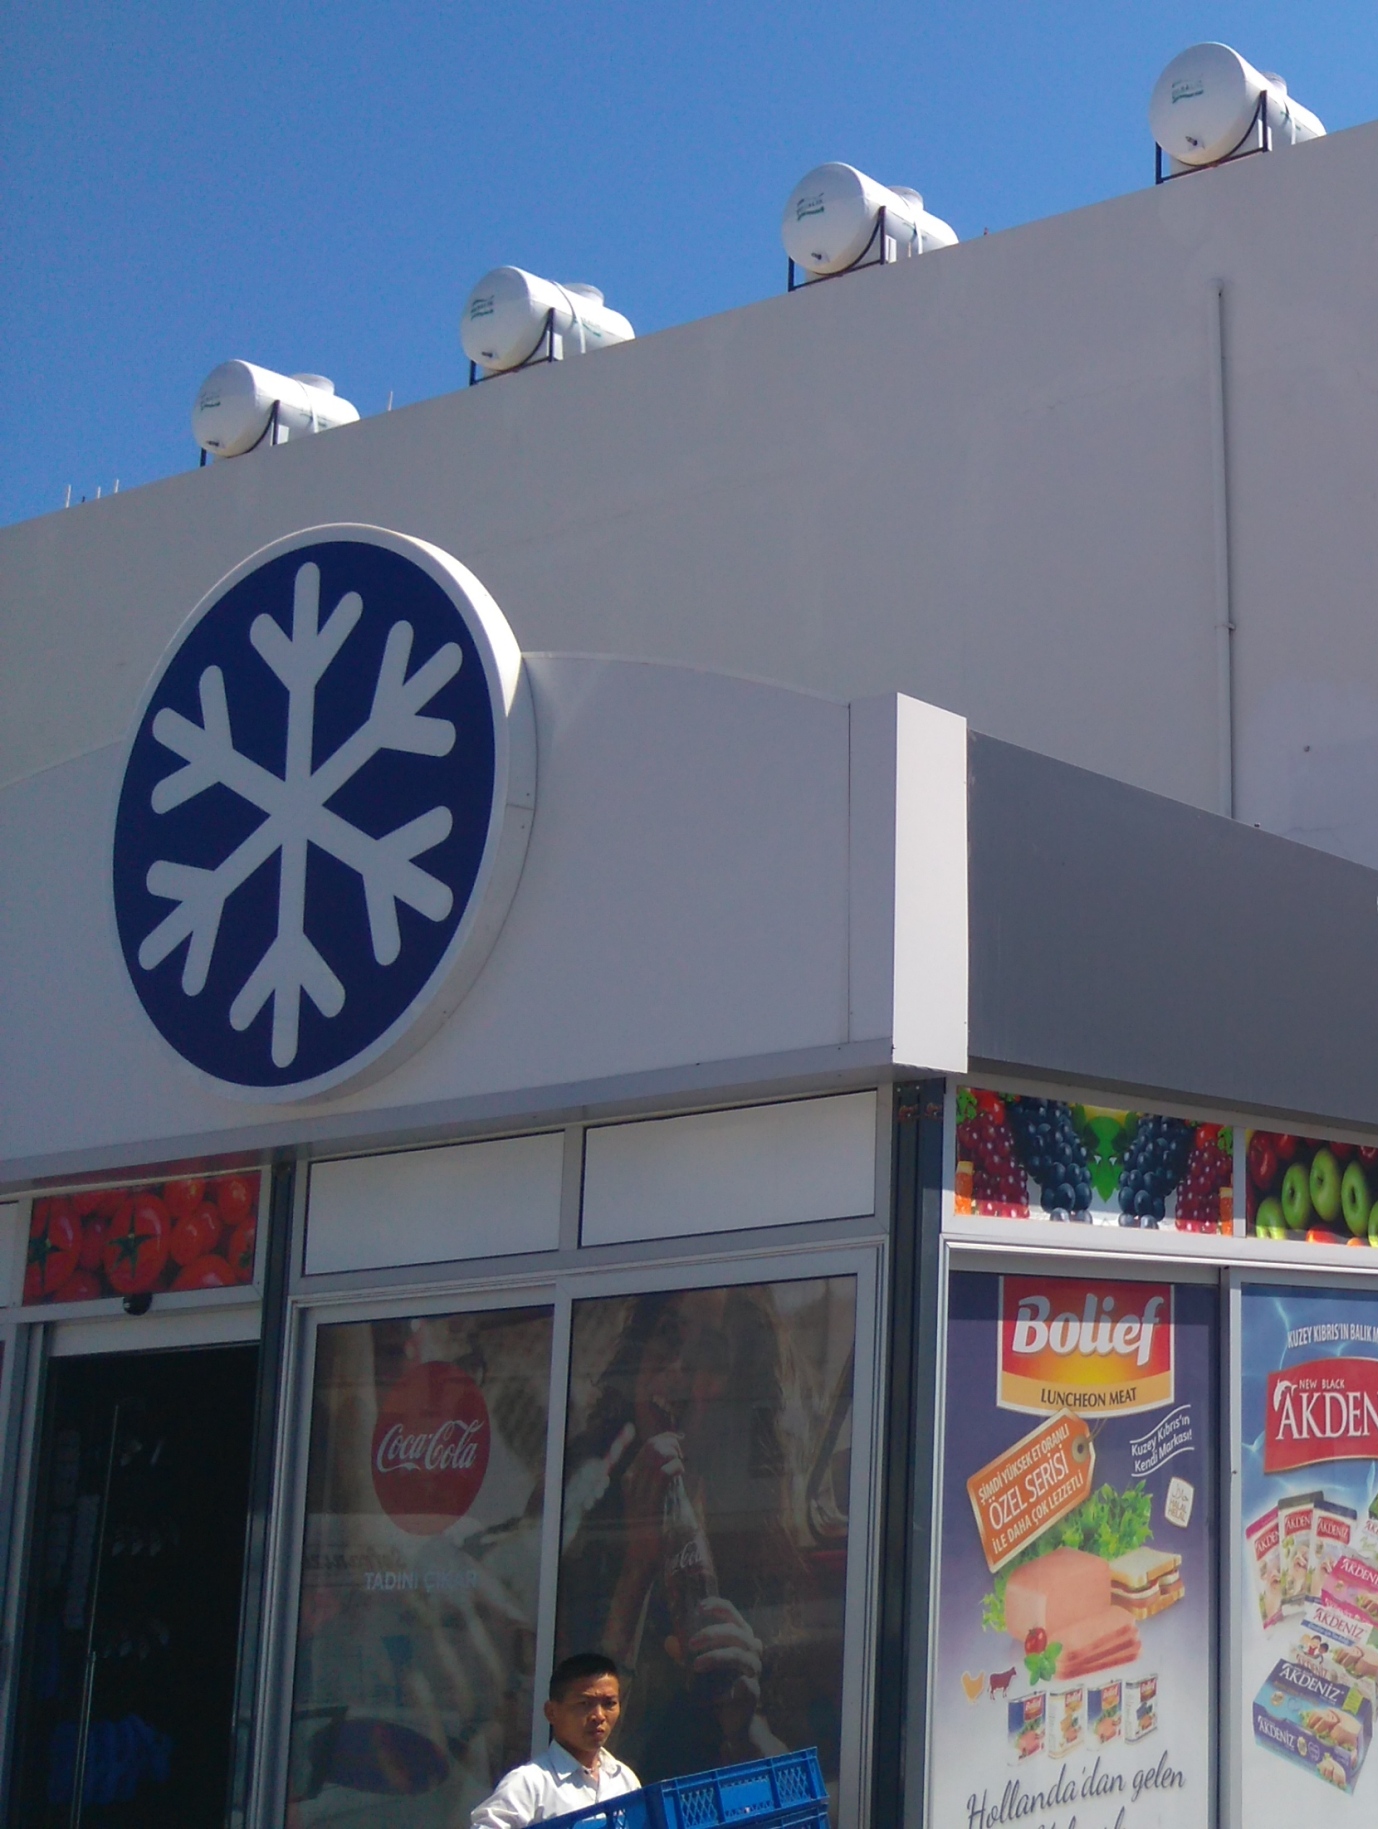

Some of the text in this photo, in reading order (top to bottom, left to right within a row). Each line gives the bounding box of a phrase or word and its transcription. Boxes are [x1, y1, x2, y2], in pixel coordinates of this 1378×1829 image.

[1012, 1293, 1164, 1367] Bolief
[1287, 1326, 1312, 1348] KUZEY
[1313, 1323, 1349, 1342] KIBRIS'IN
[1350, 1323, 1372, 1342] BALIK
[1041, 1386, 1137, 1408] LUNCHEON MEAT
[1299, 1379, 1345, 1390] NEW BLACK
[377, 1419, 485, 1473] Coca-Cola
[1001, 1454, 1033, 1484] YÜKSEK
[1031, 1444, 1042, 1463] ET
[1041, 1423, 1070, 1454] ORANLI
[1131, 1435, 1157, 1457] Kuzey
[1134, 1450, 1158, 1473] Kendi
[989, 1443, 1070, 1530] ÖZEL SERİSİ
[1007, 1515, 1032, 1543] DAHA
[1031, 1500, 1049, 1526] ÇOK
[1048, 1469, 1084, 1509] LEZZETLİ
[364, 1571, 418, 1590] TADINI
[1279, 1664, 1341, 1702] AKDENİZ
[966, 1749, 1185, 1829] Hollanda'dan gelen
